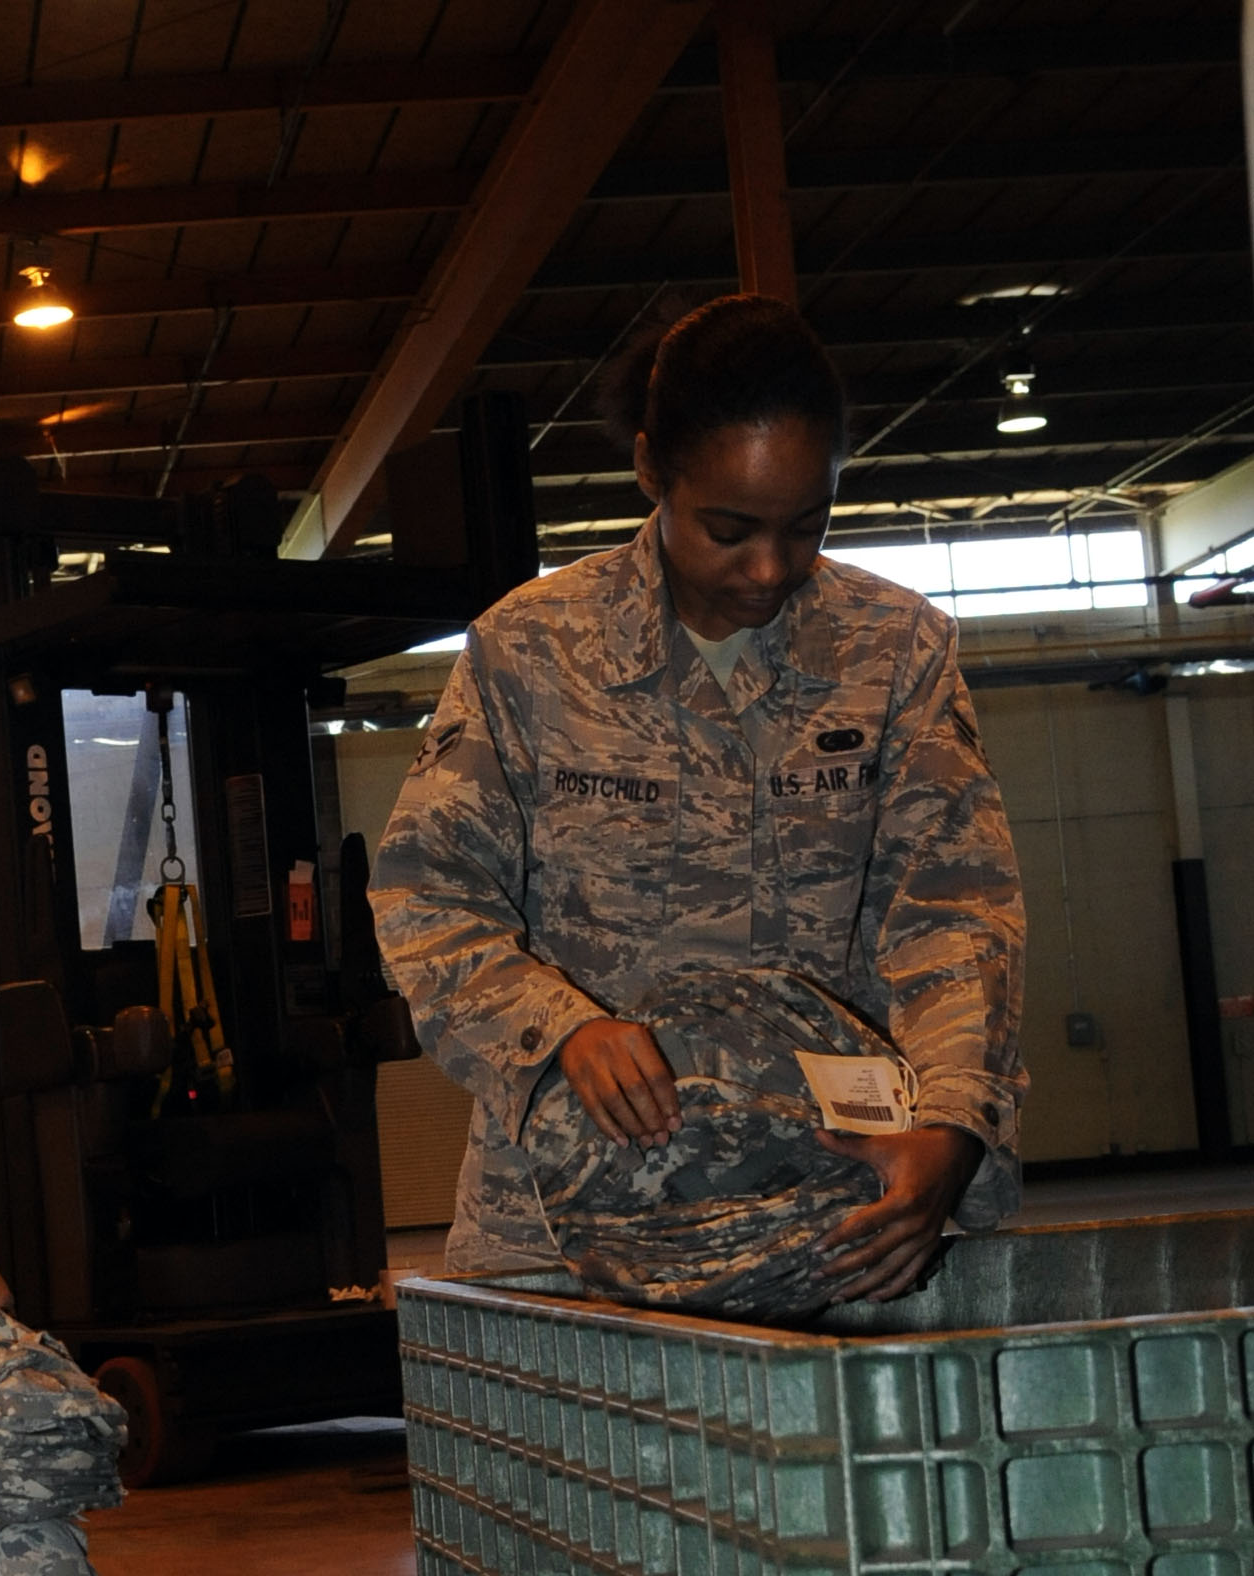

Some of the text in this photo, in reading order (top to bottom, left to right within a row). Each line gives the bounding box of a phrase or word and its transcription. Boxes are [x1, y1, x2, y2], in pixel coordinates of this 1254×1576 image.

[555, 769, 660, 803] ROSTCHILD
[770, 773, 807, 798] U.S.
[815, 765, 849, 793] AIR
